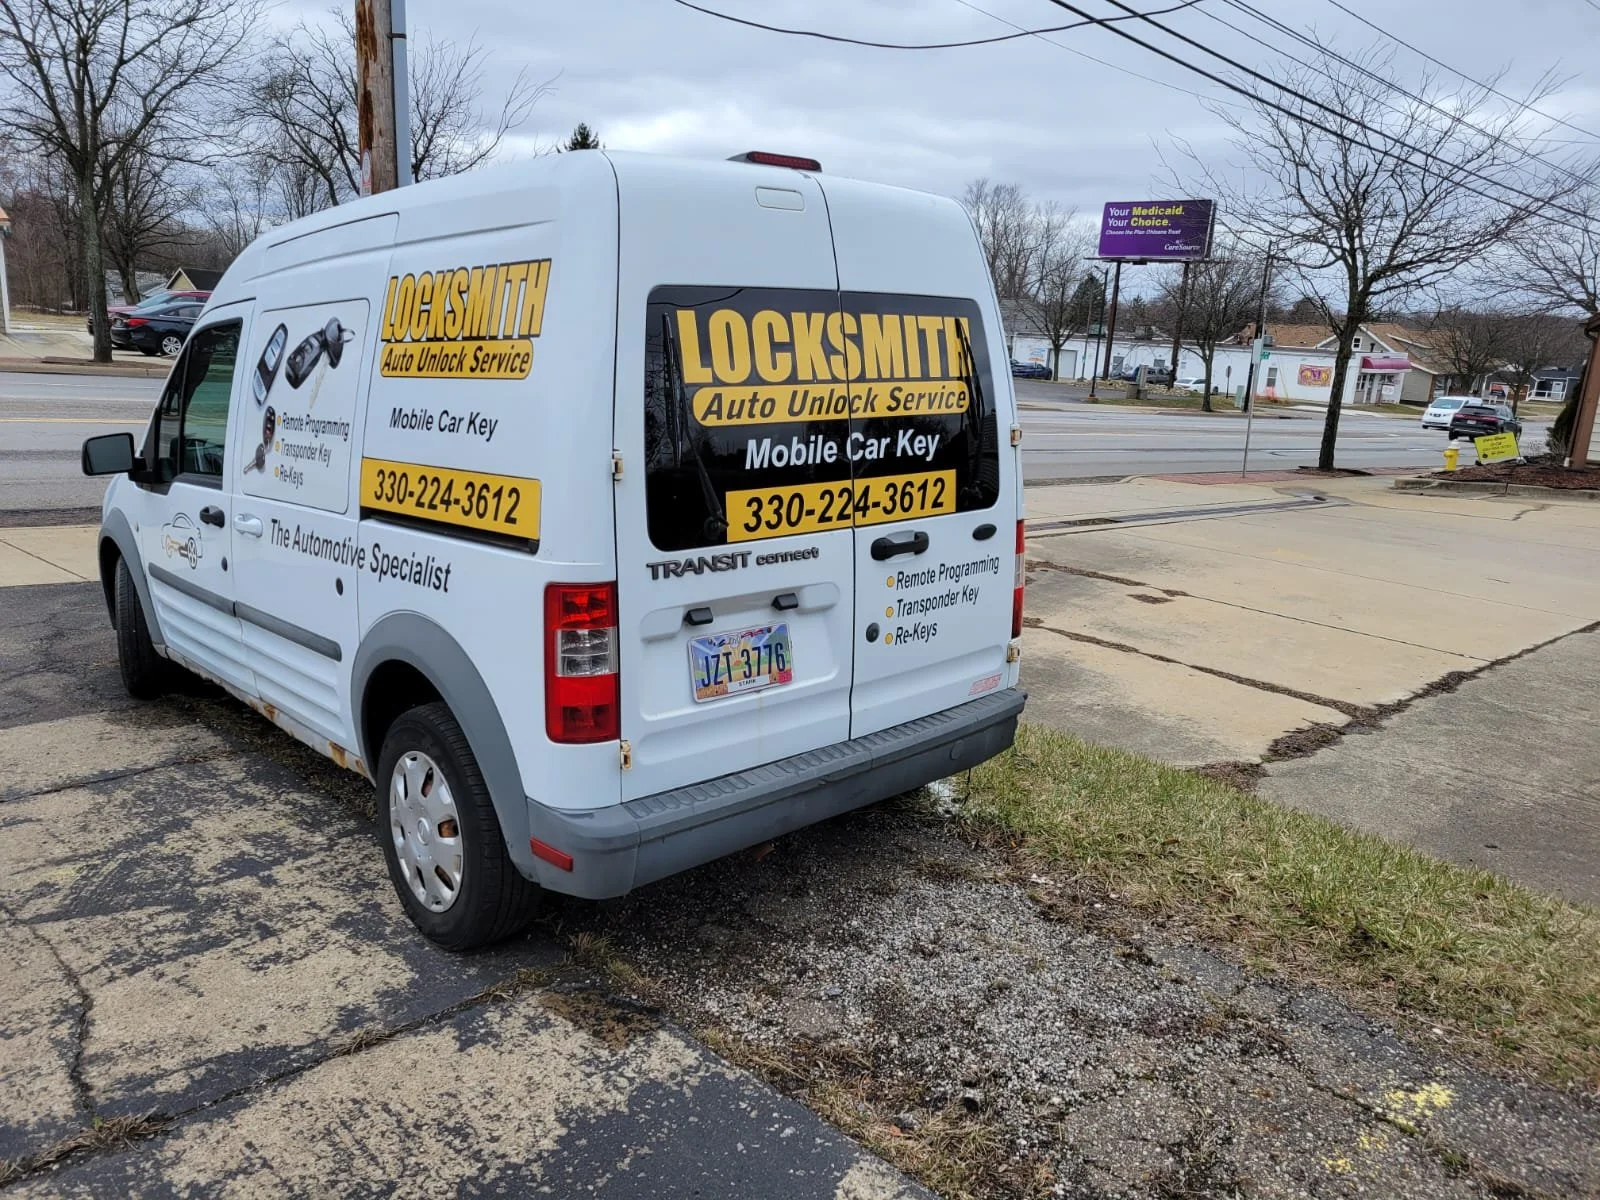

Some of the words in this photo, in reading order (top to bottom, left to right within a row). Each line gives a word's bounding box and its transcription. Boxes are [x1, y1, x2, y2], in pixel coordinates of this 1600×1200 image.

[1108, 218, 1128, 227] Your
[1130, 217, 1171, 226] Choice.
[1109, 208, 1129, 216] Your
[1132, 205, 1184, 215] Medicaid.
[381, 258, 552, 341] LOCKSMITH
[382, 346, 413, 373] Auto
[417, 344, 466, 373] Unlock
[469, 339, 530, 374] Service
[676, 309, 972, 384] LOCKSMITH
[700, 390, 776, 422] Auto
[787, 386, 879, 418] Unlock
[886, 384, 967, 412] Service
[282, 412, 304, 431] Remote
[304, 413, 350, 442] Programming
[389, 407, 434, 431] Mobile
[438, 410, 465, 434] Car
[466, 412, 498, 443] Key
[281, 438, 318, 462] Transponder
[318, 443, 332, 468] Key
[744, 434, 838, 470] Mobile
[846, 432, 890, 462] Car
[896, 428, 940, 462] Key
[279, 464, 304, 489] Re-Keys
[374, 469, 521, 526] 330-224-3612
[743, 477, 946, 533] 330-224-3612
[270, 518, 290, 549] The
[293, 523, 367, 570] Automotive
[370, 545, 452, 593] Specialist
[646, 550, 752, 581] TRANSIT
[756, 546, 820, 567] connect
[896, 571, 936, 591] Remote
[938, 554, 1000, 580] Programming
[896, 593, 959, 619] Transponder
[961, 586, 980, 605] Key
[895, 621, 938, 646] Re-Keys
[701, 651, 732, 687] JZT
[741, 642, 786, 679] 3776
